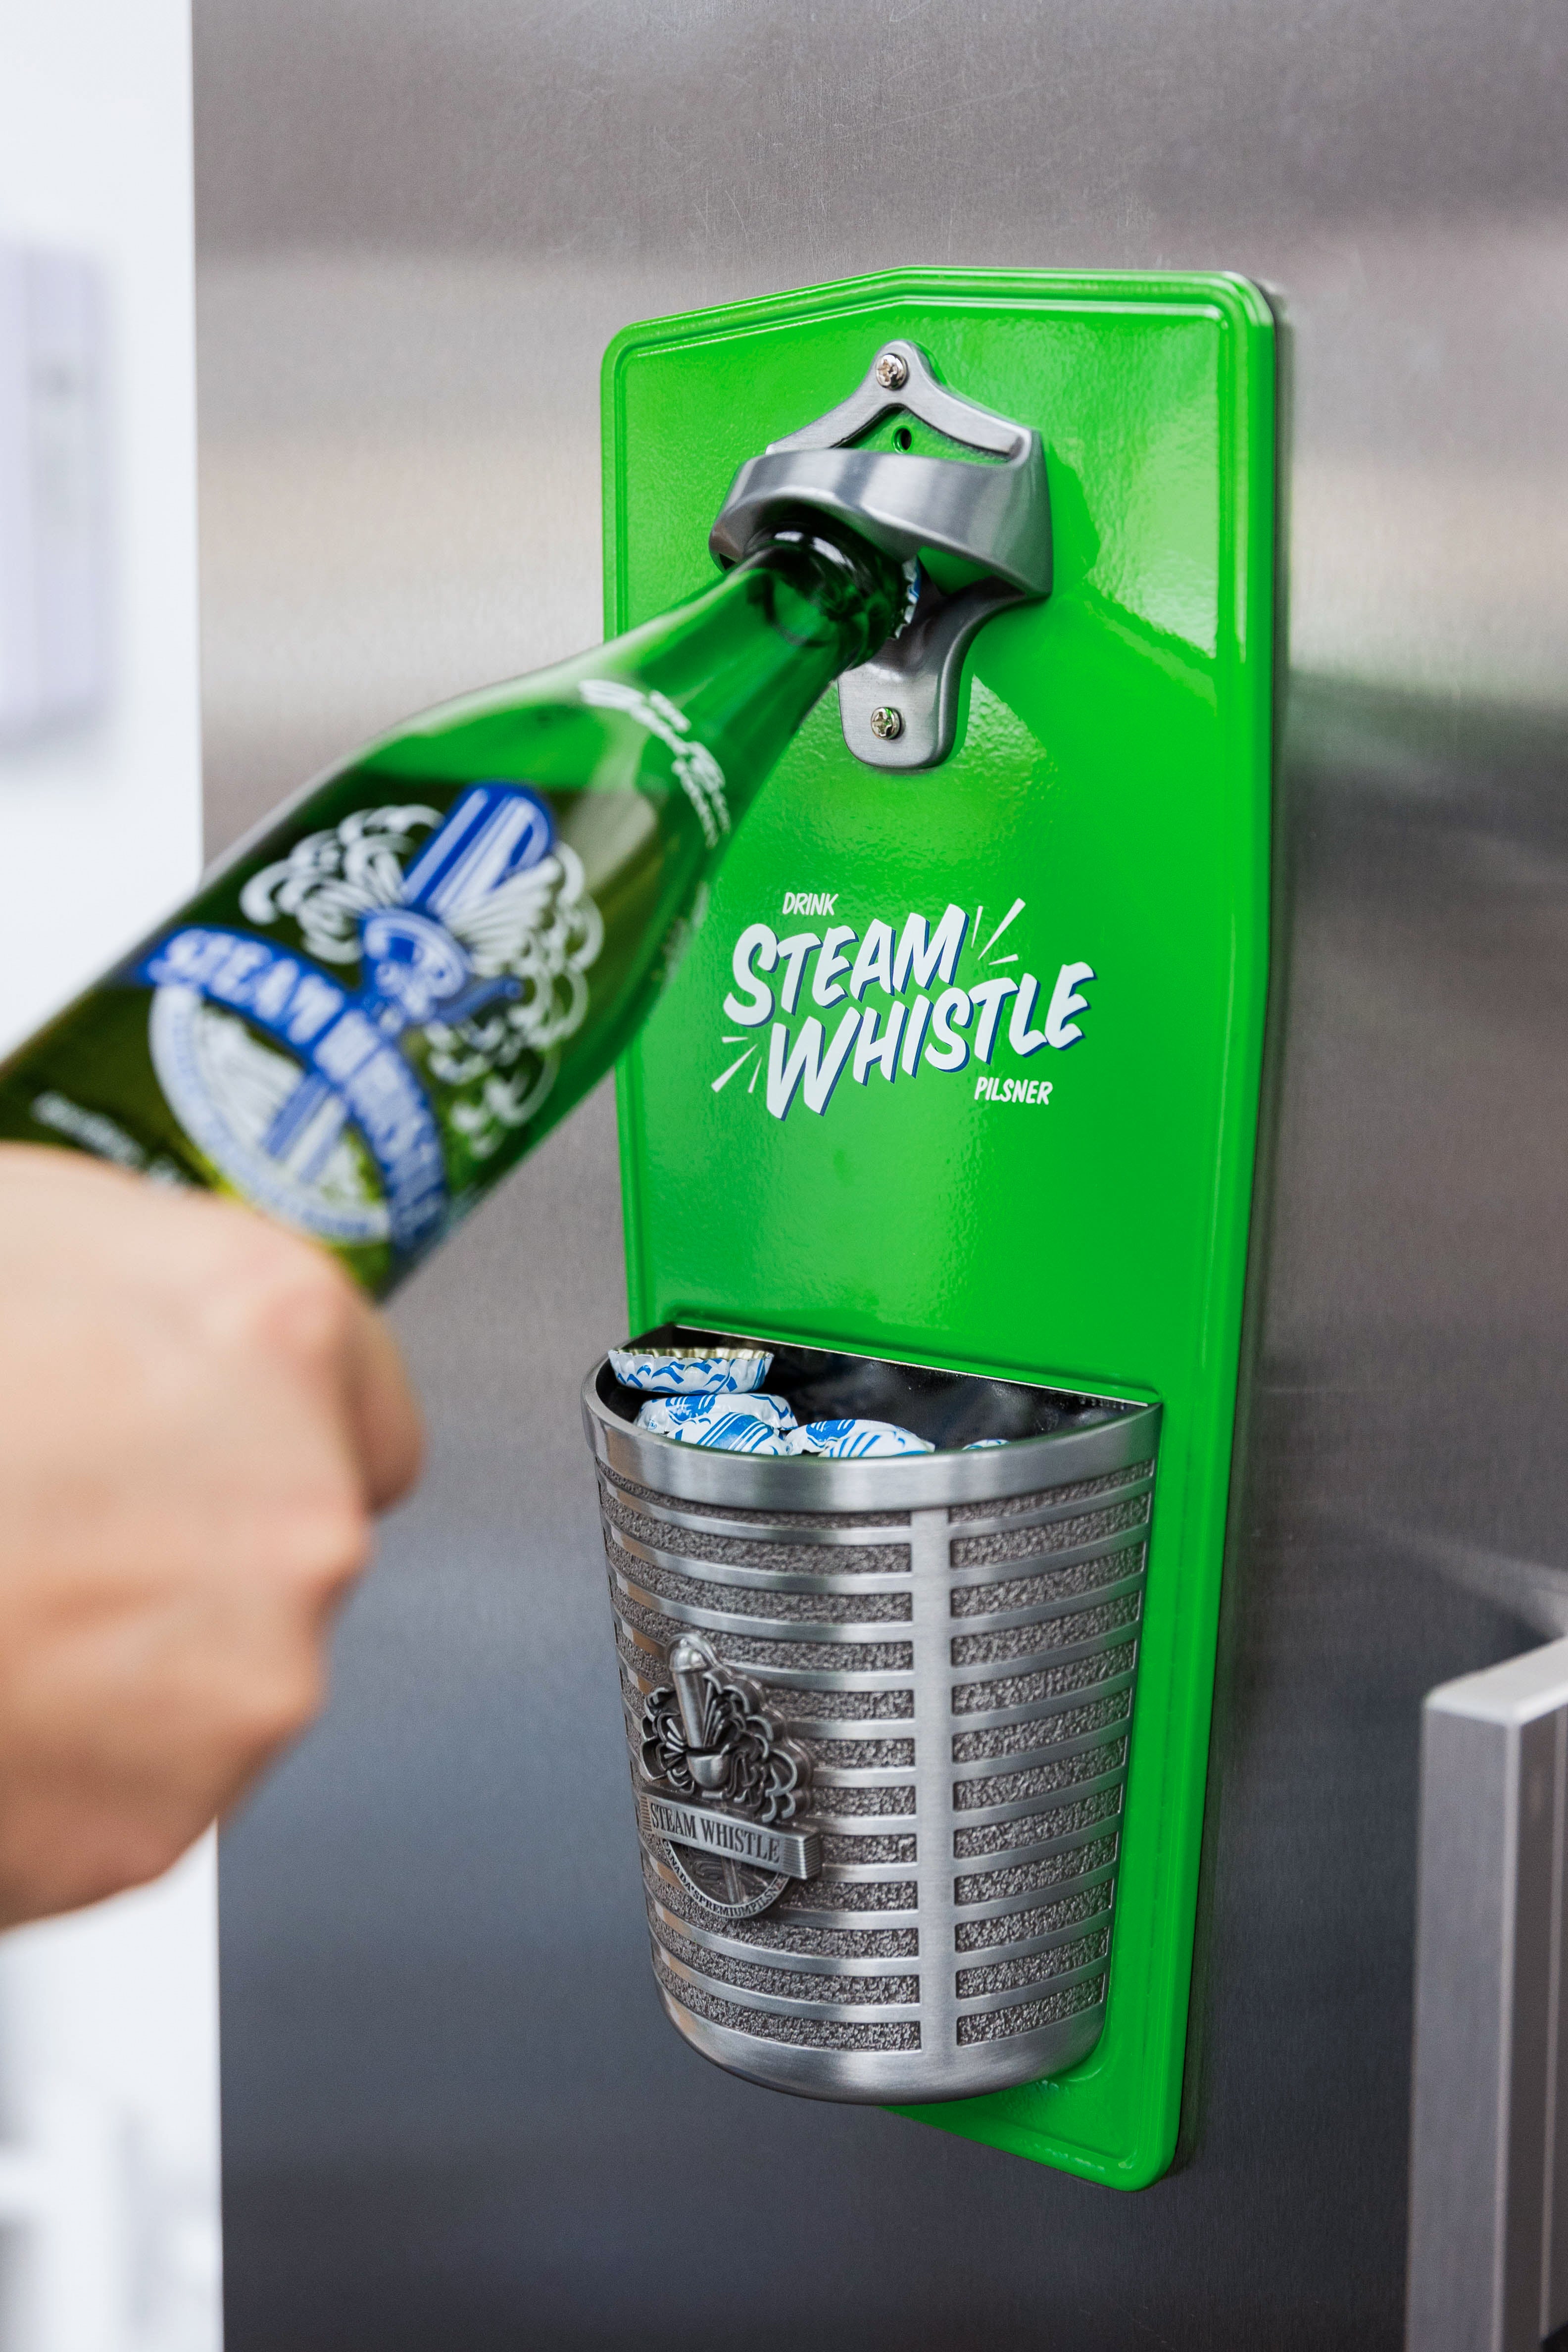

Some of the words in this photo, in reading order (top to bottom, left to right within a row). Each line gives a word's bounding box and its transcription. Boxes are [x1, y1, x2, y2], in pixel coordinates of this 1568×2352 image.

[783, 892, 838, 916] DRINK
[724, 904, 970, 1028] STEAM
[766, 961, 1096, 1121] WHISTLE
[975, 1077, 1053, 1105] PILSNER
[651, 1803, 697, 1839] STEAM
[700, 1818, 781, 1863] WHISTLE
